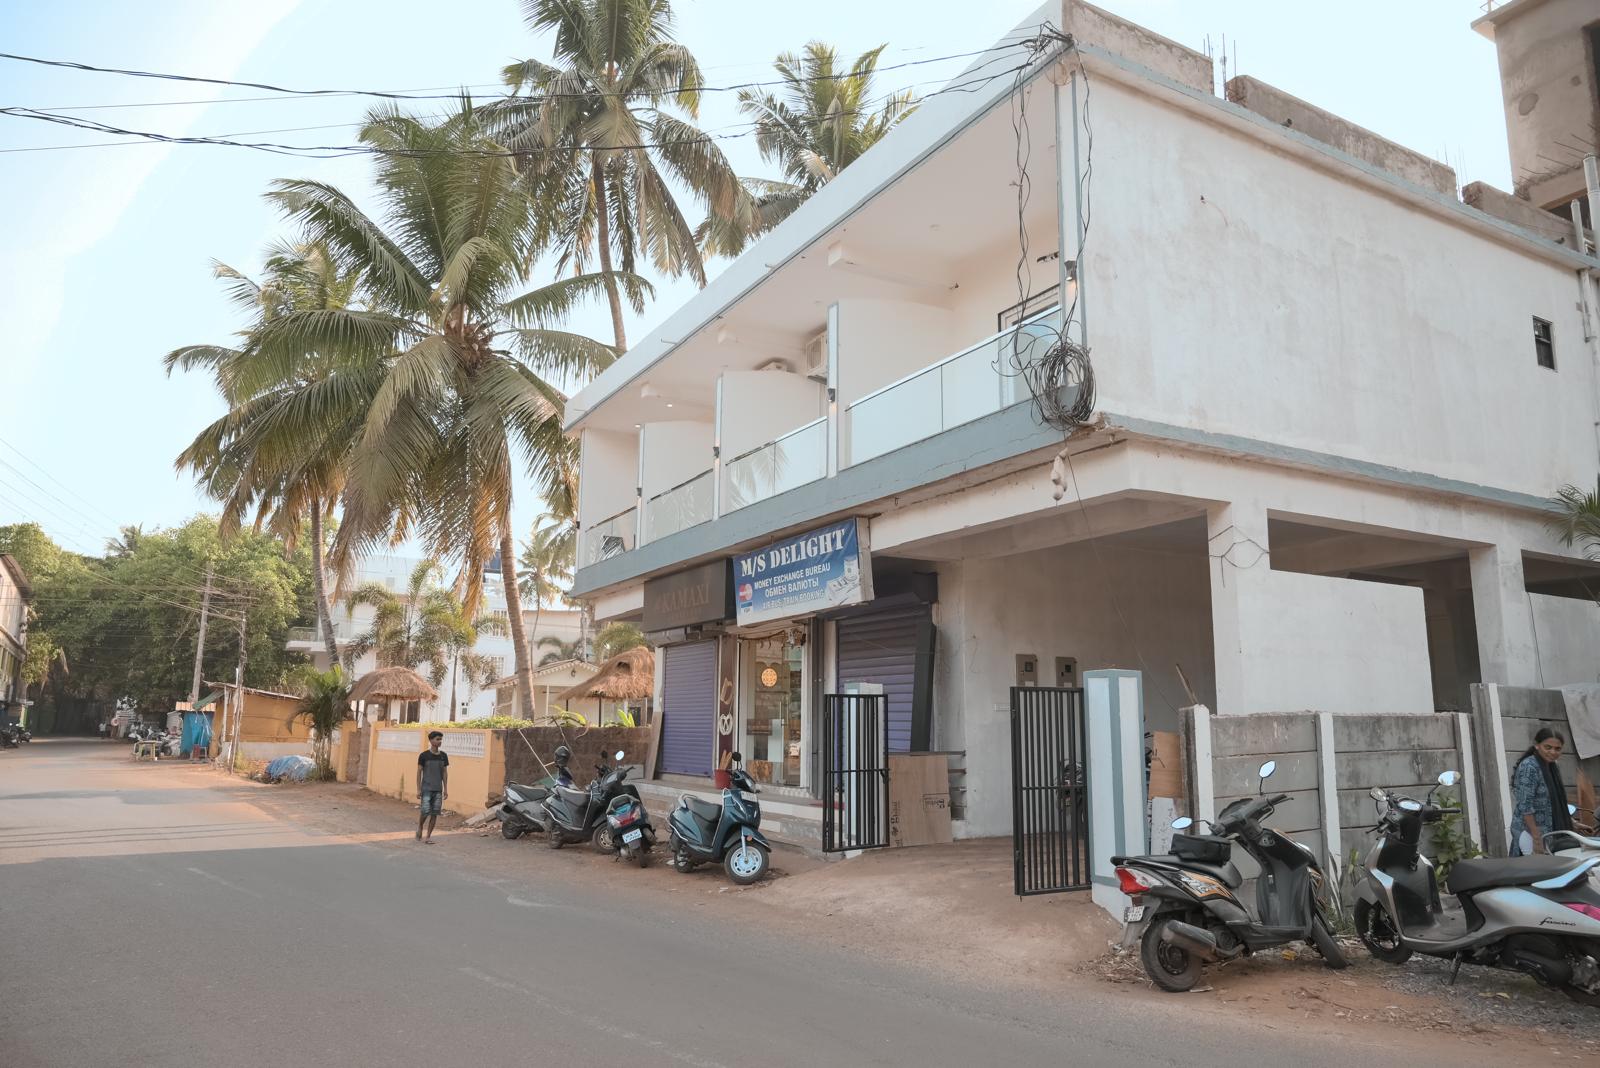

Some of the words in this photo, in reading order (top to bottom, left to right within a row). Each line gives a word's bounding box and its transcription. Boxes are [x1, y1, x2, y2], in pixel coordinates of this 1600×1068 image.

[740, 553, 766, 577] M/S
[769, 529, 845, 569] DELIGHT
[754, 577, 773, 589] MONEY
[773, 569, 804, 584] EXCHANGE
[805, 562, 831, 577] BUREAU
[764, 585, 787, 598] ОБМЕН
[788, 577, 819, 593] ВАЛЮТЫ
